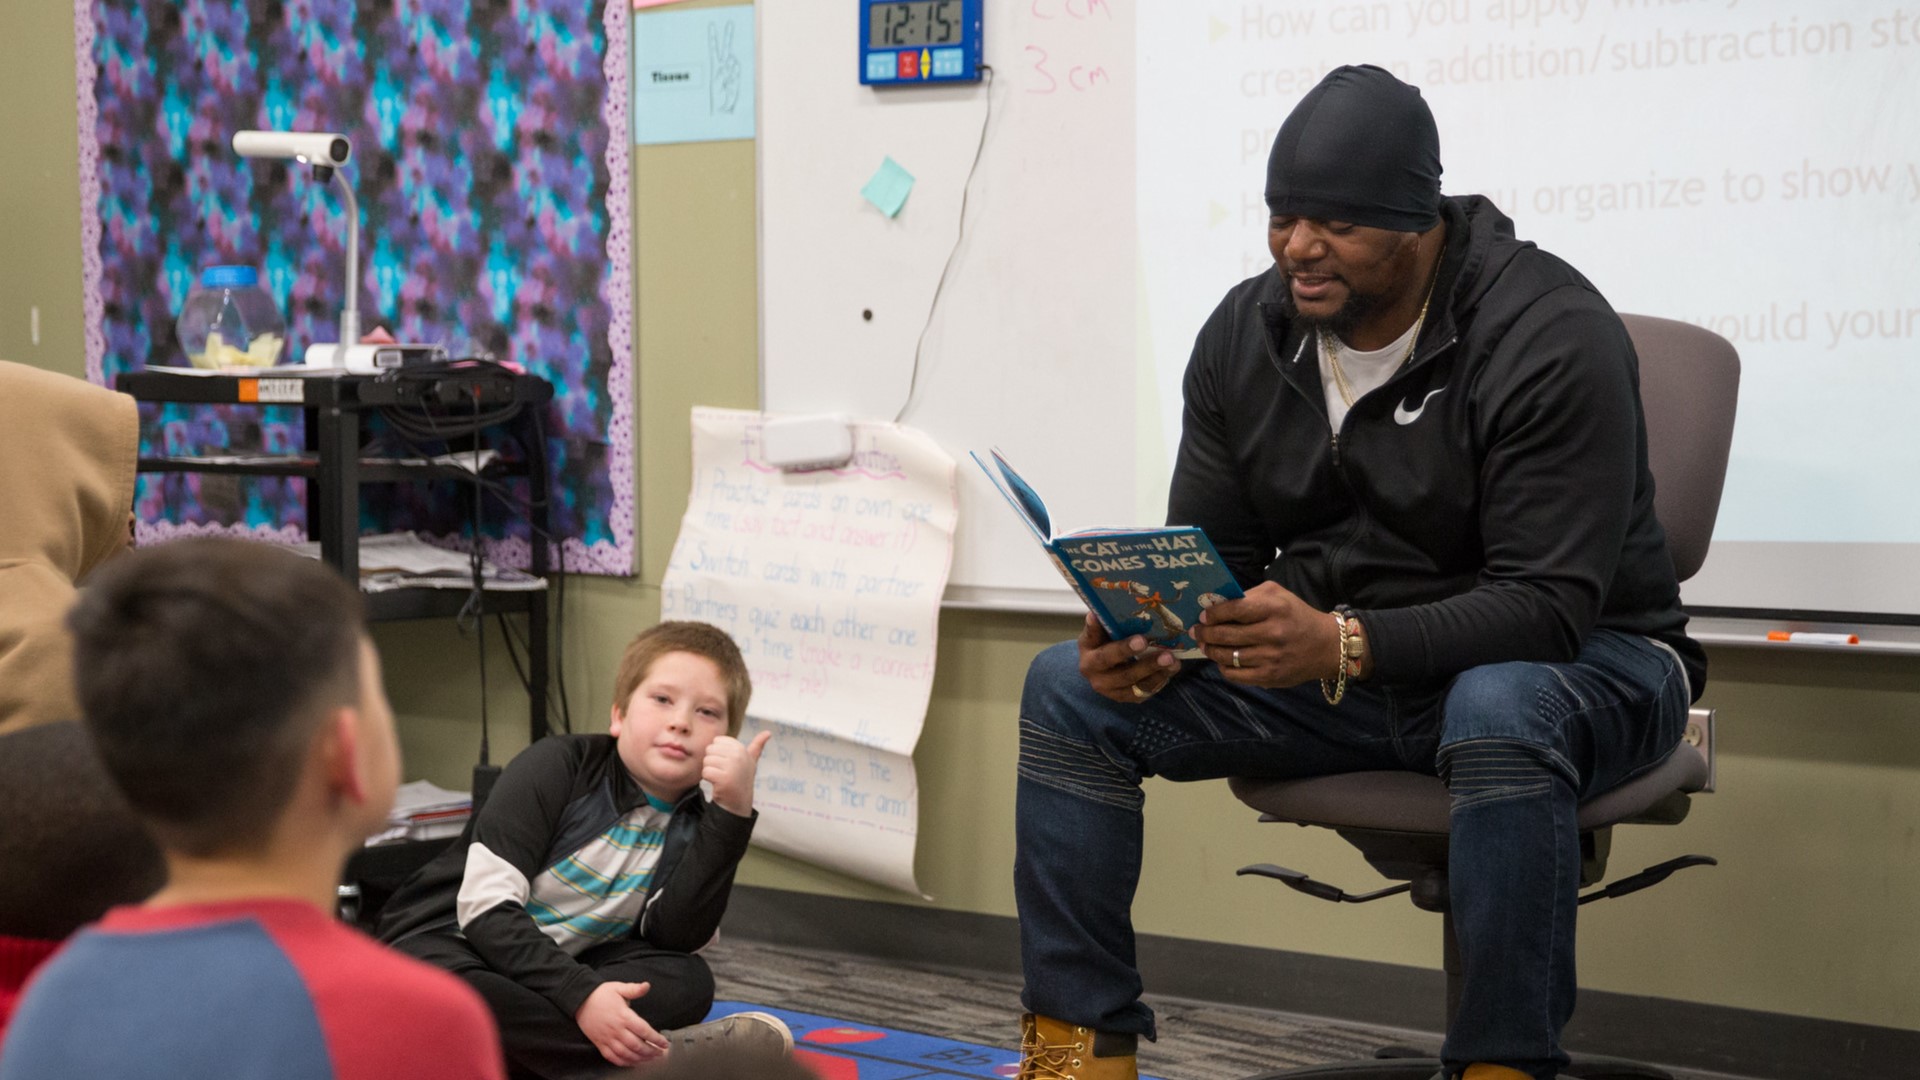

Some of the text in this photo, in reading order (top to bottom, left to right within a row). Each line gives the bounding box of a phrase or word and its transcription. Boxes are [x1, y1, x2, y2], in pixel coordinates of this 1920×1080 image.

[884, 1, 951, 45] 12:15
[1241, 5, 1316, 40] How
[1328, 2, 1391, 35] can
[1406, 0, 1470, 37] you
[1024, 44, 1110, 94] 3 cm
[1427, 16, 1854, 86] addition/subtraction
[1533, 169, 1706, 223] organize
[1721, 167, 1766, 204] to
[1780, 157, 1893, 200] show
[832, 494, 848, 513] on
[855, 497, 893, 519] own
[1071, 555, 1147, 573] COMES
[1147, 551, 1215, 569] BACK
[1080, 541, 1120, 557] CAT
[1120, 544, 1133, 552] IN
[1135, 542, 1154, 551] THE
[1151, 535, 1198, 551] HAT
[689, 541, 749, 577] Switch
[763, 552, 801, 584] cards
[810, 557, 847, 591] with
[854, 564, 926, 598] partner
[684, 582, 738, 623] Partners
[748, 606, 781, 633] quiz
[790, 602, 826, 633] each
[832, 604, 879, 641] other
[887, 627, 918, 647] one
[762, 637, 794, 660] time
[850, 653, 862, 670] a
[814, 784, 831, 804] on
[875, 795, 909, 817] arm
